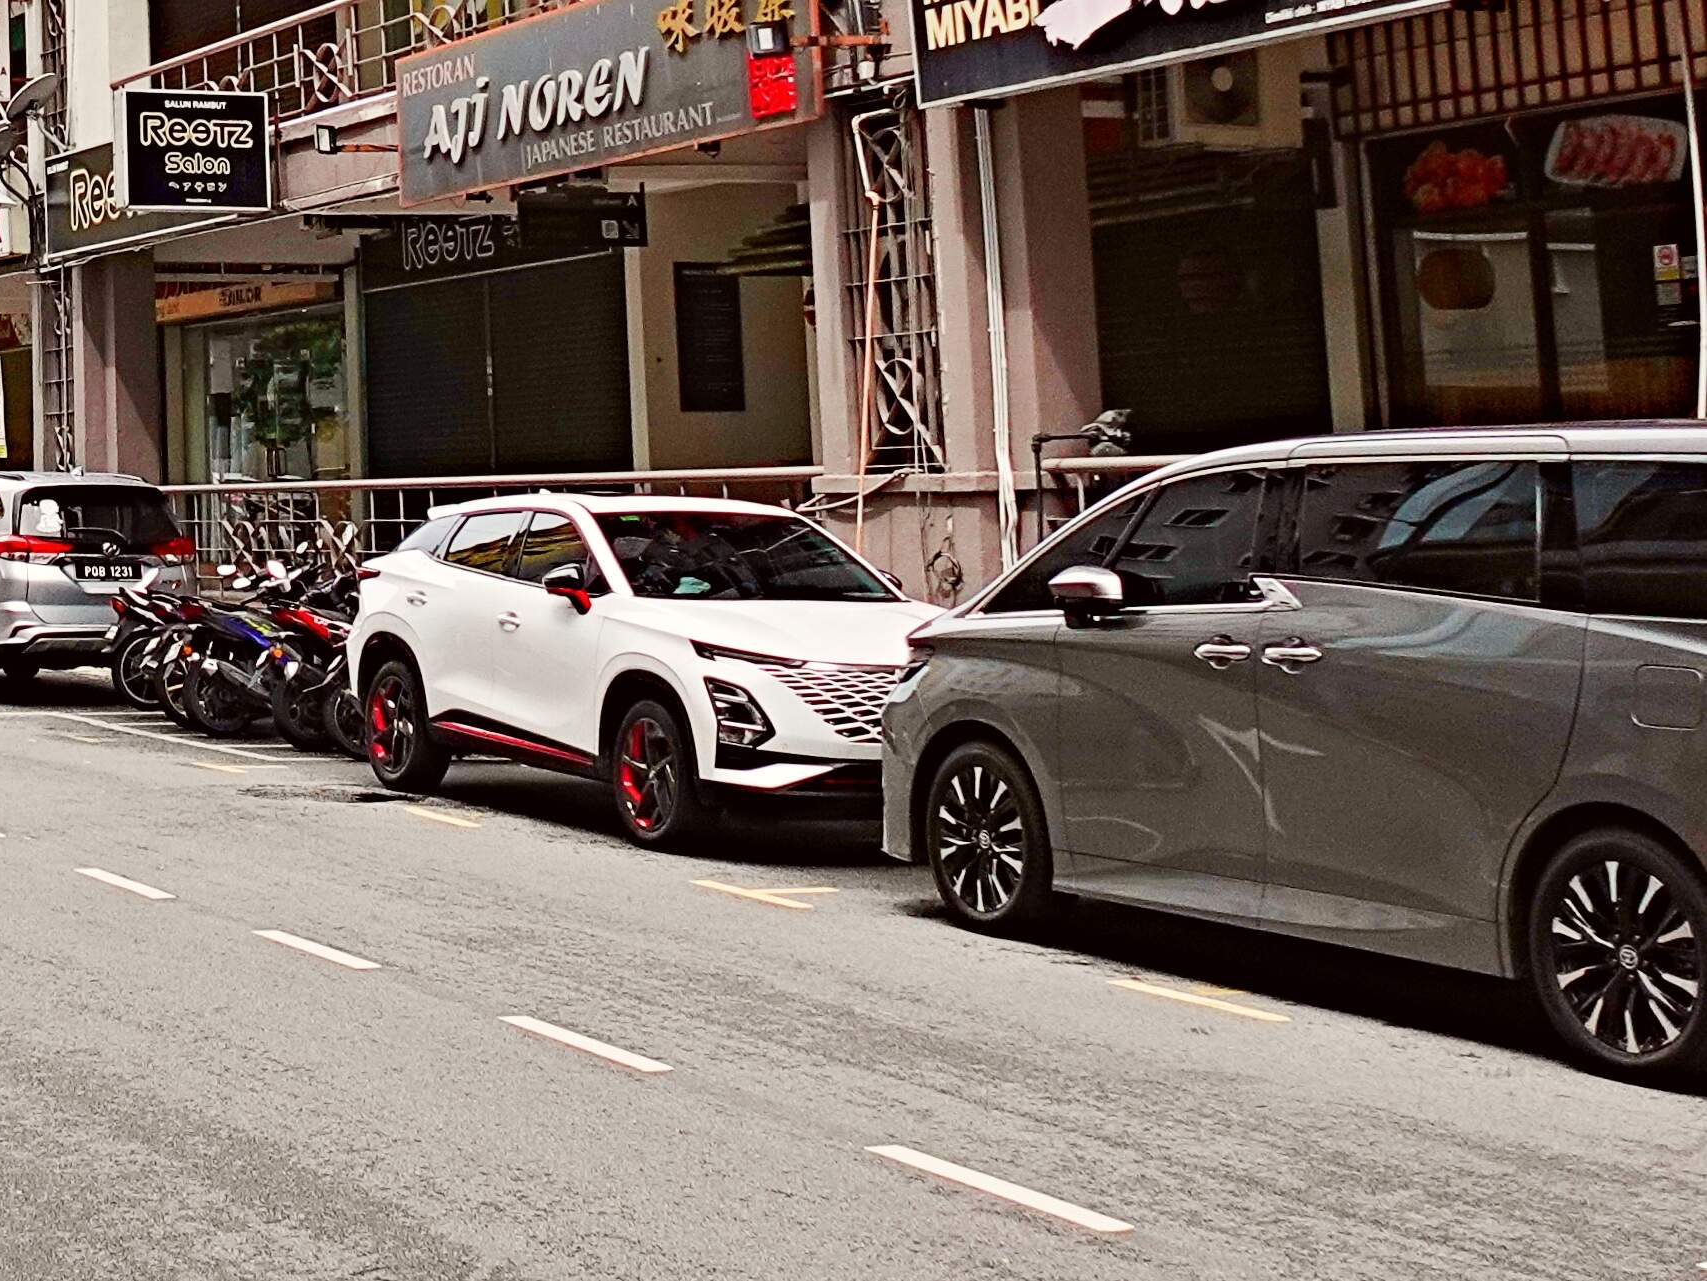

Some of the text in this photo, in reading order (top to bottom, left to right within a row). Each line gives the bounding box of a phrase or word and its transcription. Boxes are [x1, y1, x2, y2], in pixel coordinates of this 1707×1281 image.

[403, 52, 476, 98] RESTORAN
[164, 99, 227, 110] SALUN RAMBUT
[496, 46, 651, 141] NOREN
[526, 101, 714, 169] JAPANESE RESTAURANT
[164, 151, 231, 175] Salon
[110, 565, 133, 578] 1231
